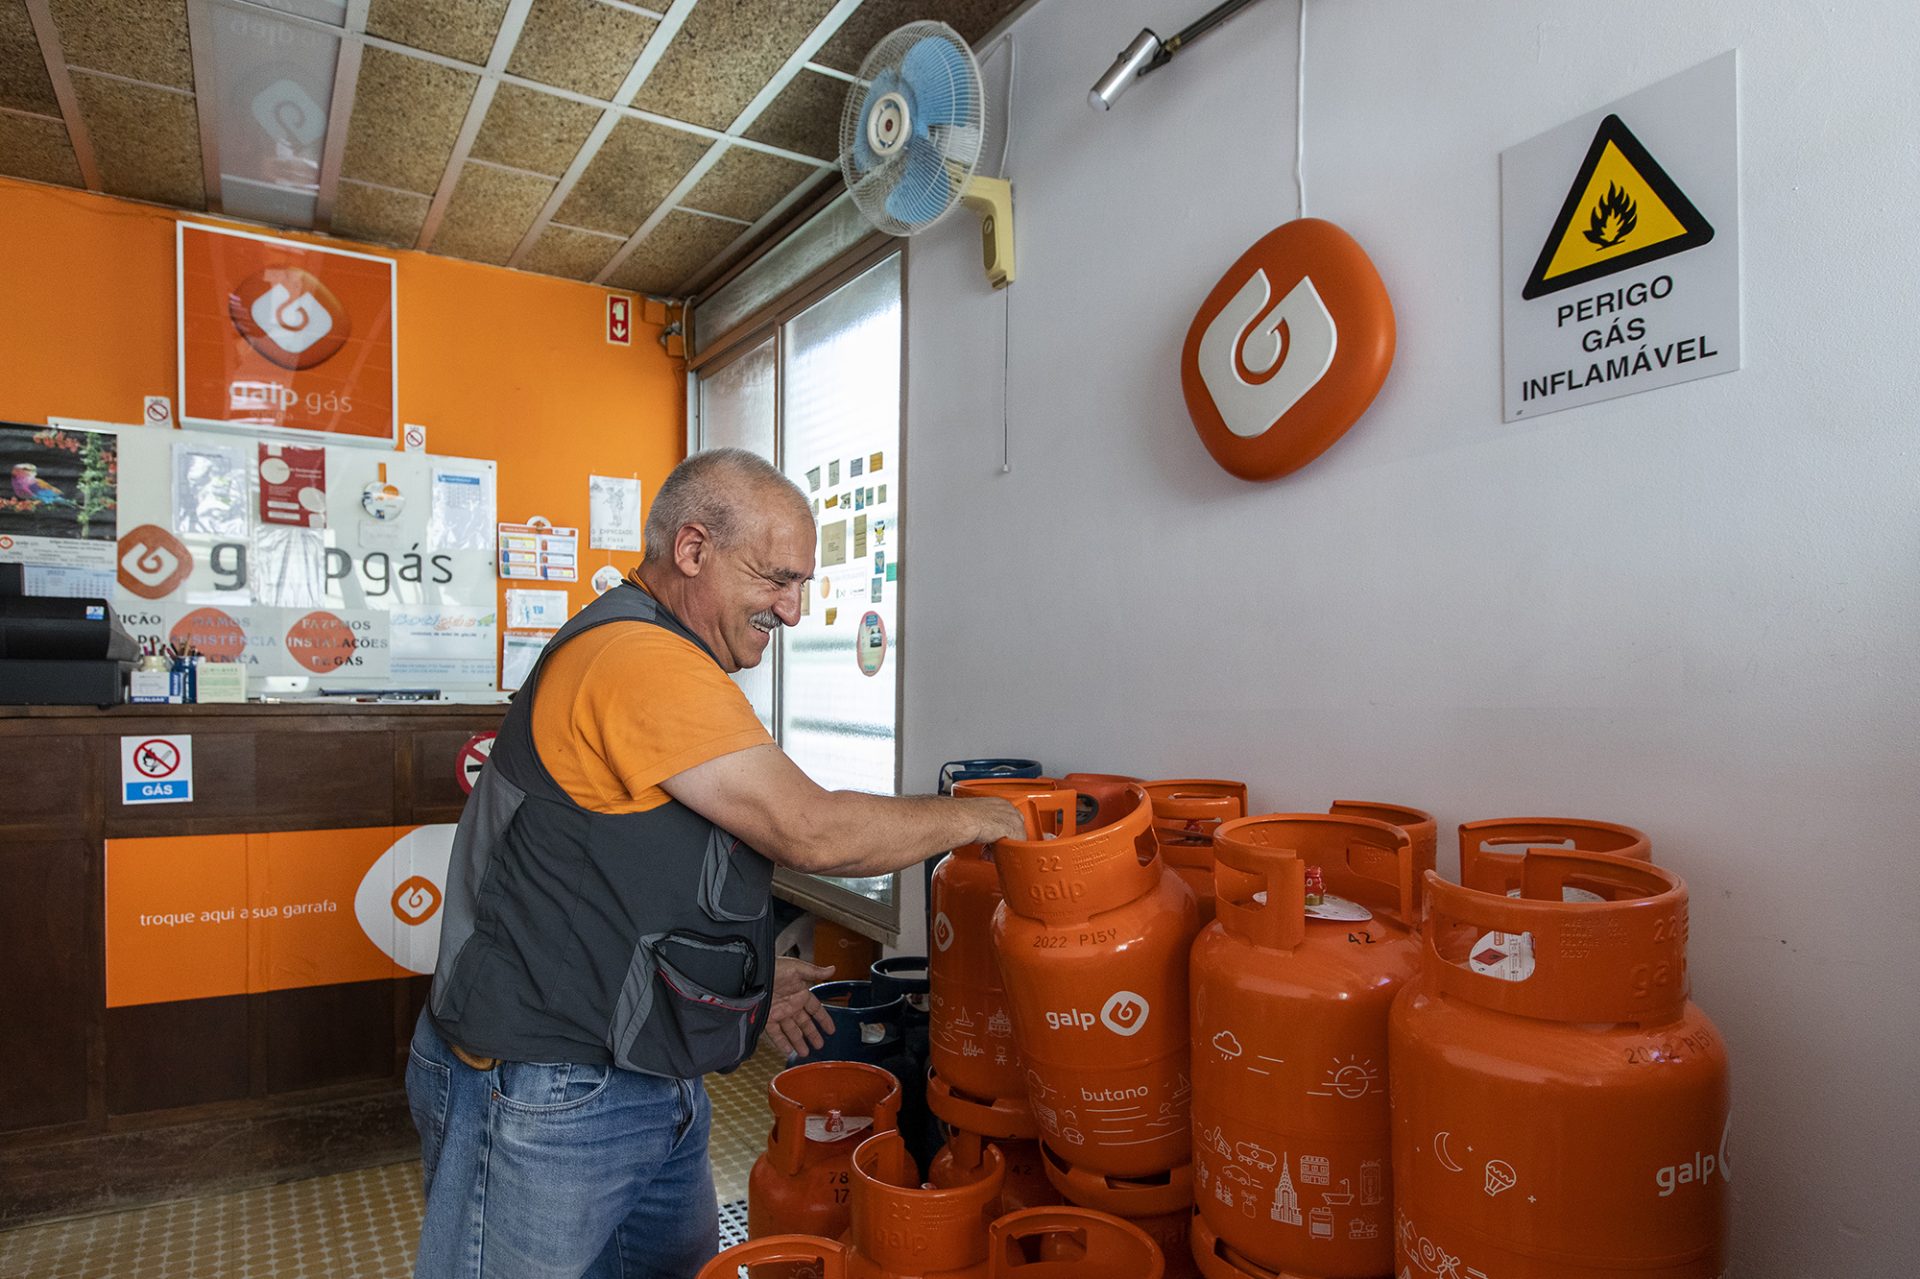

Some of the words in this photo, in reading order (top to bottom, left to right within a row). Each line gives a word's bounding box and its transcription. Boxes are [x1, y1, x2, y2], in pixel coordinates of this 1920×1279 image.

[1557, 274, 1673, 327] PERIGO
[1582, 317, 1646, 352] GÁS
[1522, 335, 1718, 402] INFLAMÁVEL
[229, 381, 299, 411] galp
[305, 390, 353, 415] gás
[141, 781, 174, 796] GÁS
[1036, 855, 1063, 873] 22
[1028, 878, 1089, 905] galp
[139, 911, 196, 927] troque
[200, 906, 235, 924] aqui
[239, 907, 249, 919] a
[252, 905, 278, 919] sua
[282, 899, 338, 919] garrafa
[1033, 936, 1068, 949] 2022
[1079, 928, 1118, 947] P15Y
[1045, 1008, 1096, 1031] galp
[1081, 1085, 1149, 1102] butano
[1656, 1151, 1716, 1197] galp
